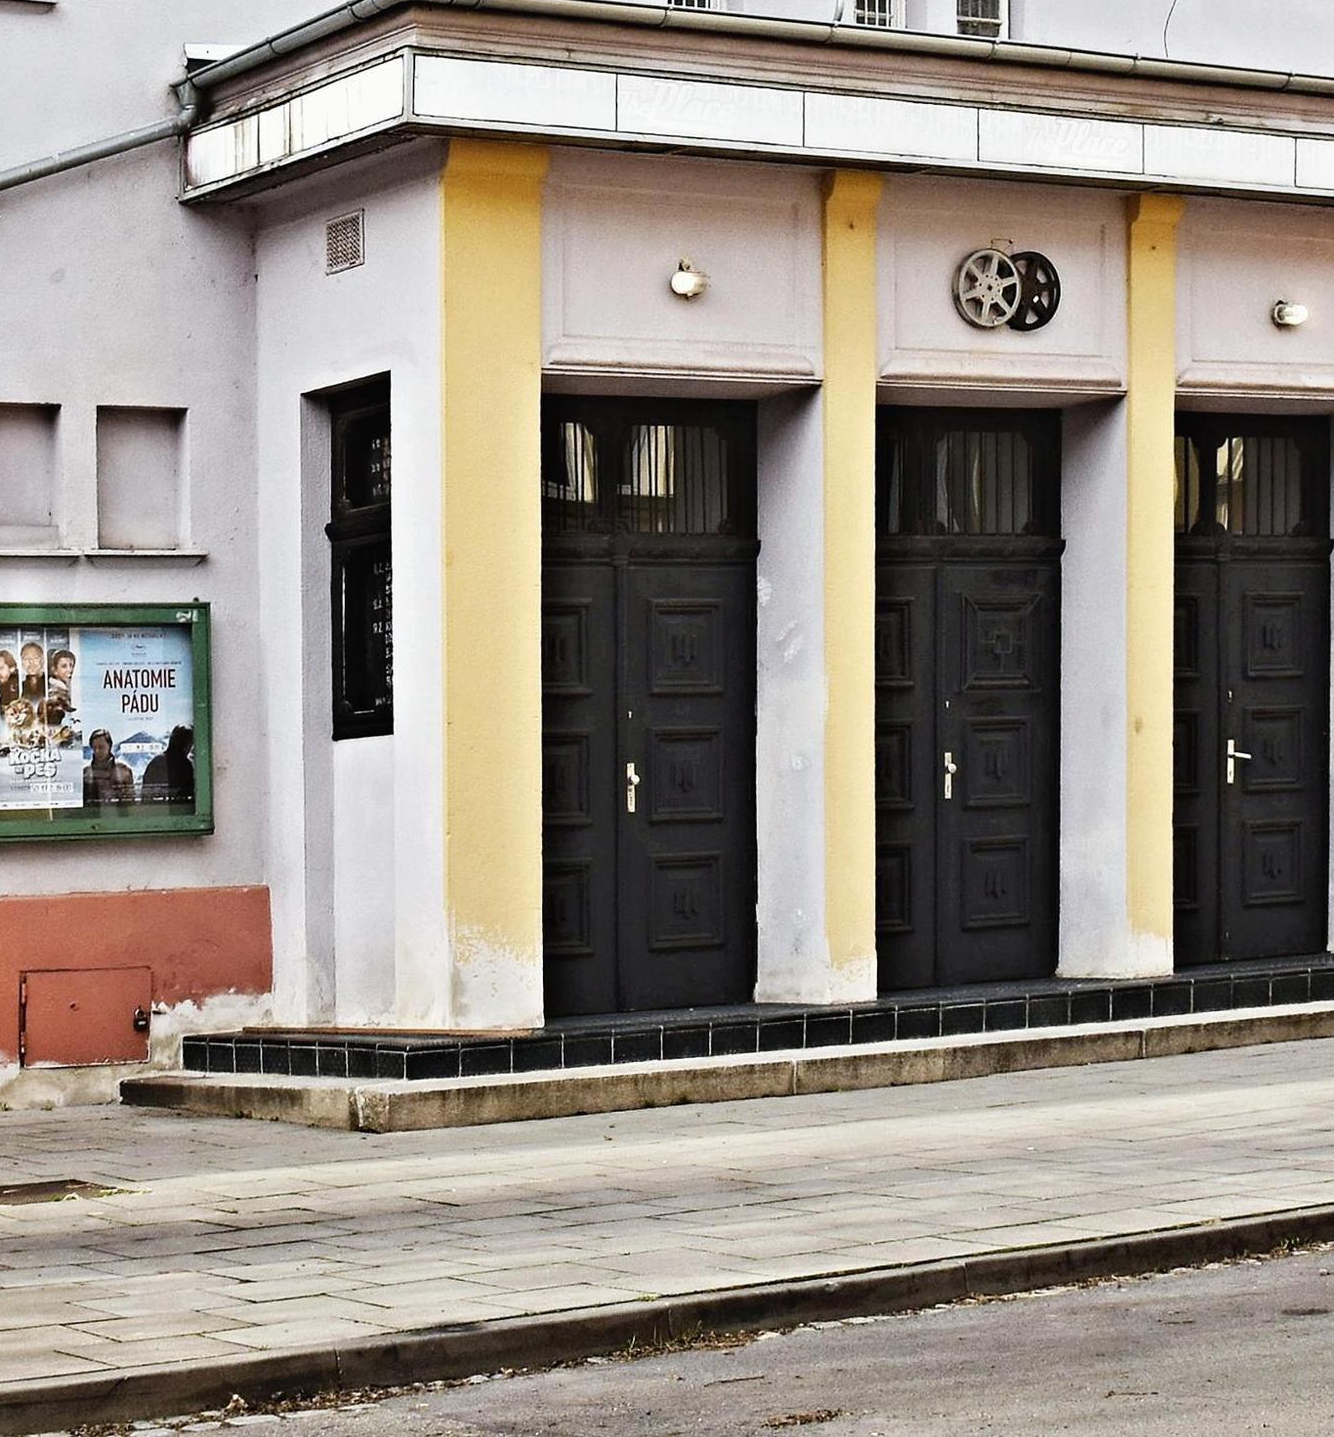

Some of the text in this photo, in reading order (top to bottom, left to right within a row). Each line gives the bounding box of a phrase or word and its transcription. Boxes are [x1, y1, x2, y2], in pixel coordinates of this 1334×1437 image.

[103, 669, 176, 689] ANATOMIE
[121, 689, 159, 713] PÁDU
[23, 762, 58, 780] PES
